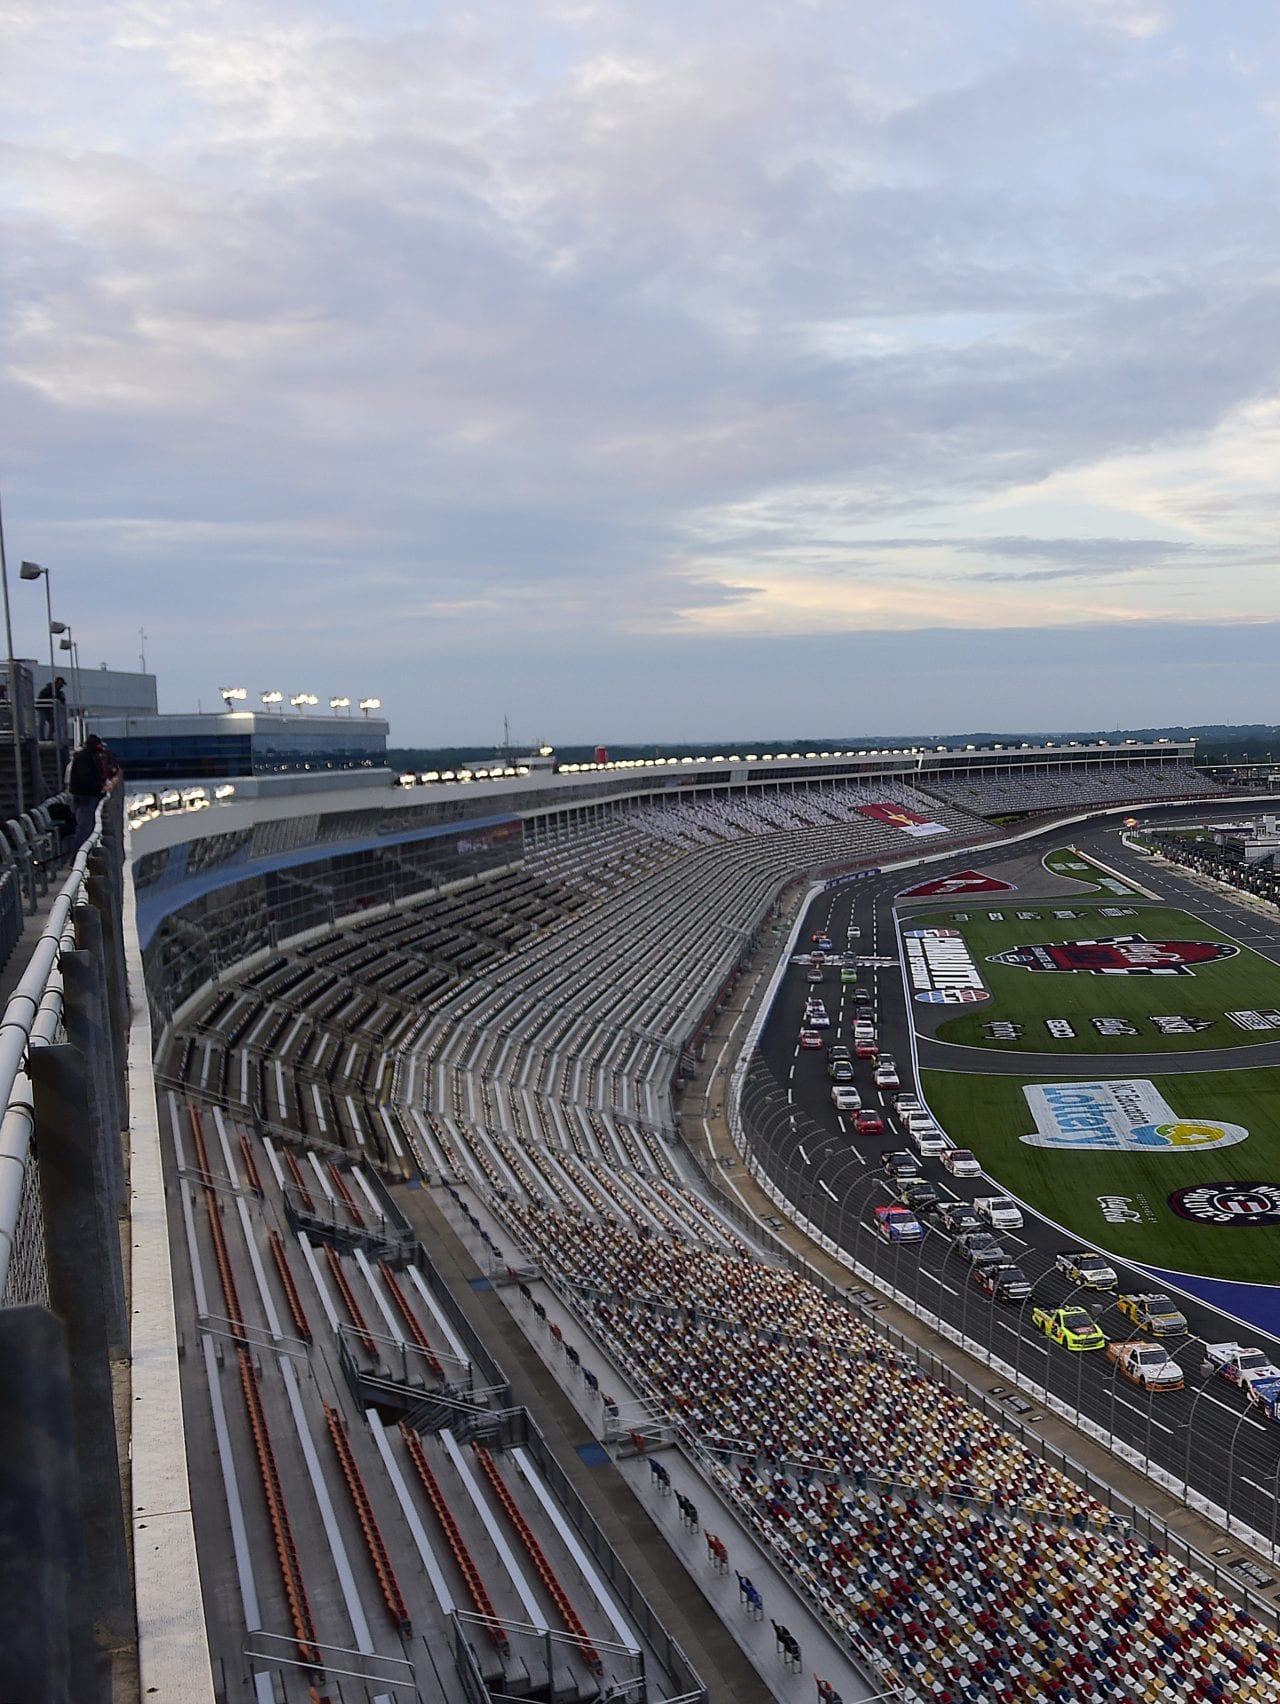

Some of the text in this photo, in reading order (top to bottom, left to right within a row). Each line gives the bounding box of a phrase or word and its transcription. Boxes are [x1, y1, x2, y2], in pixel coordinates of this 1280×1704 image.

[908, 956, 932, 990] SPEEDWAY
[923, 937, 984, 990] CHARLOTTE
[1046, 1019, 1076, 1038] GEICO
[1149, 1016, 1197, 1034] BUSCH
[1107, 1082, 1130, 1096] NC
[1042, 1085, 1120, 1146] Lottery
[1183, 1188, 1235, 1222] SALUTES
